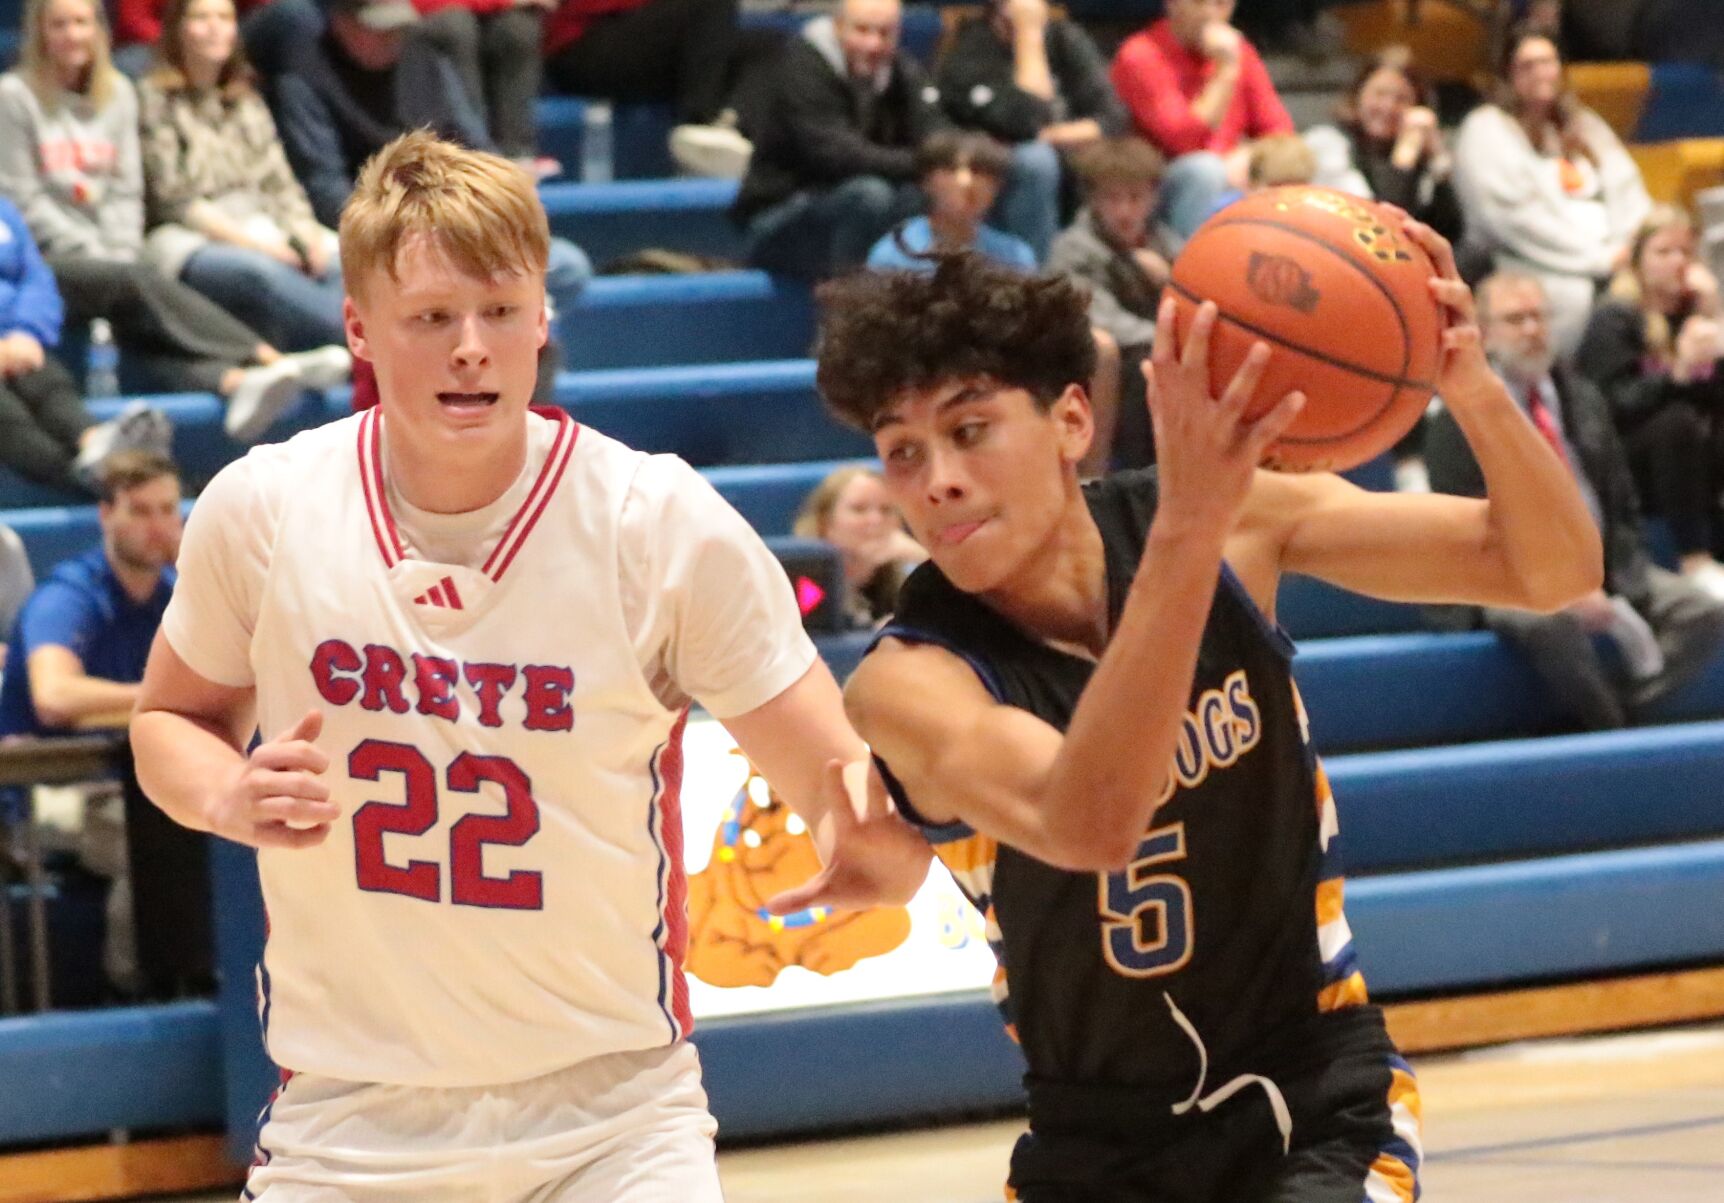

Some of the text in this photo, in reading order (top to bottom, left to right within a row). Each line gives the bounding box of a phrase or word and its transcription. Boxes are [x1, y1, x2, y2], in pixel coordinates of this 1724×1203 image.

[309, 638, 575, 732] CRETE
[1153, 669, 1261, 806] OGS
[347, 737, 543, 911] 22
[1098, 821, 1194, 979] 5
